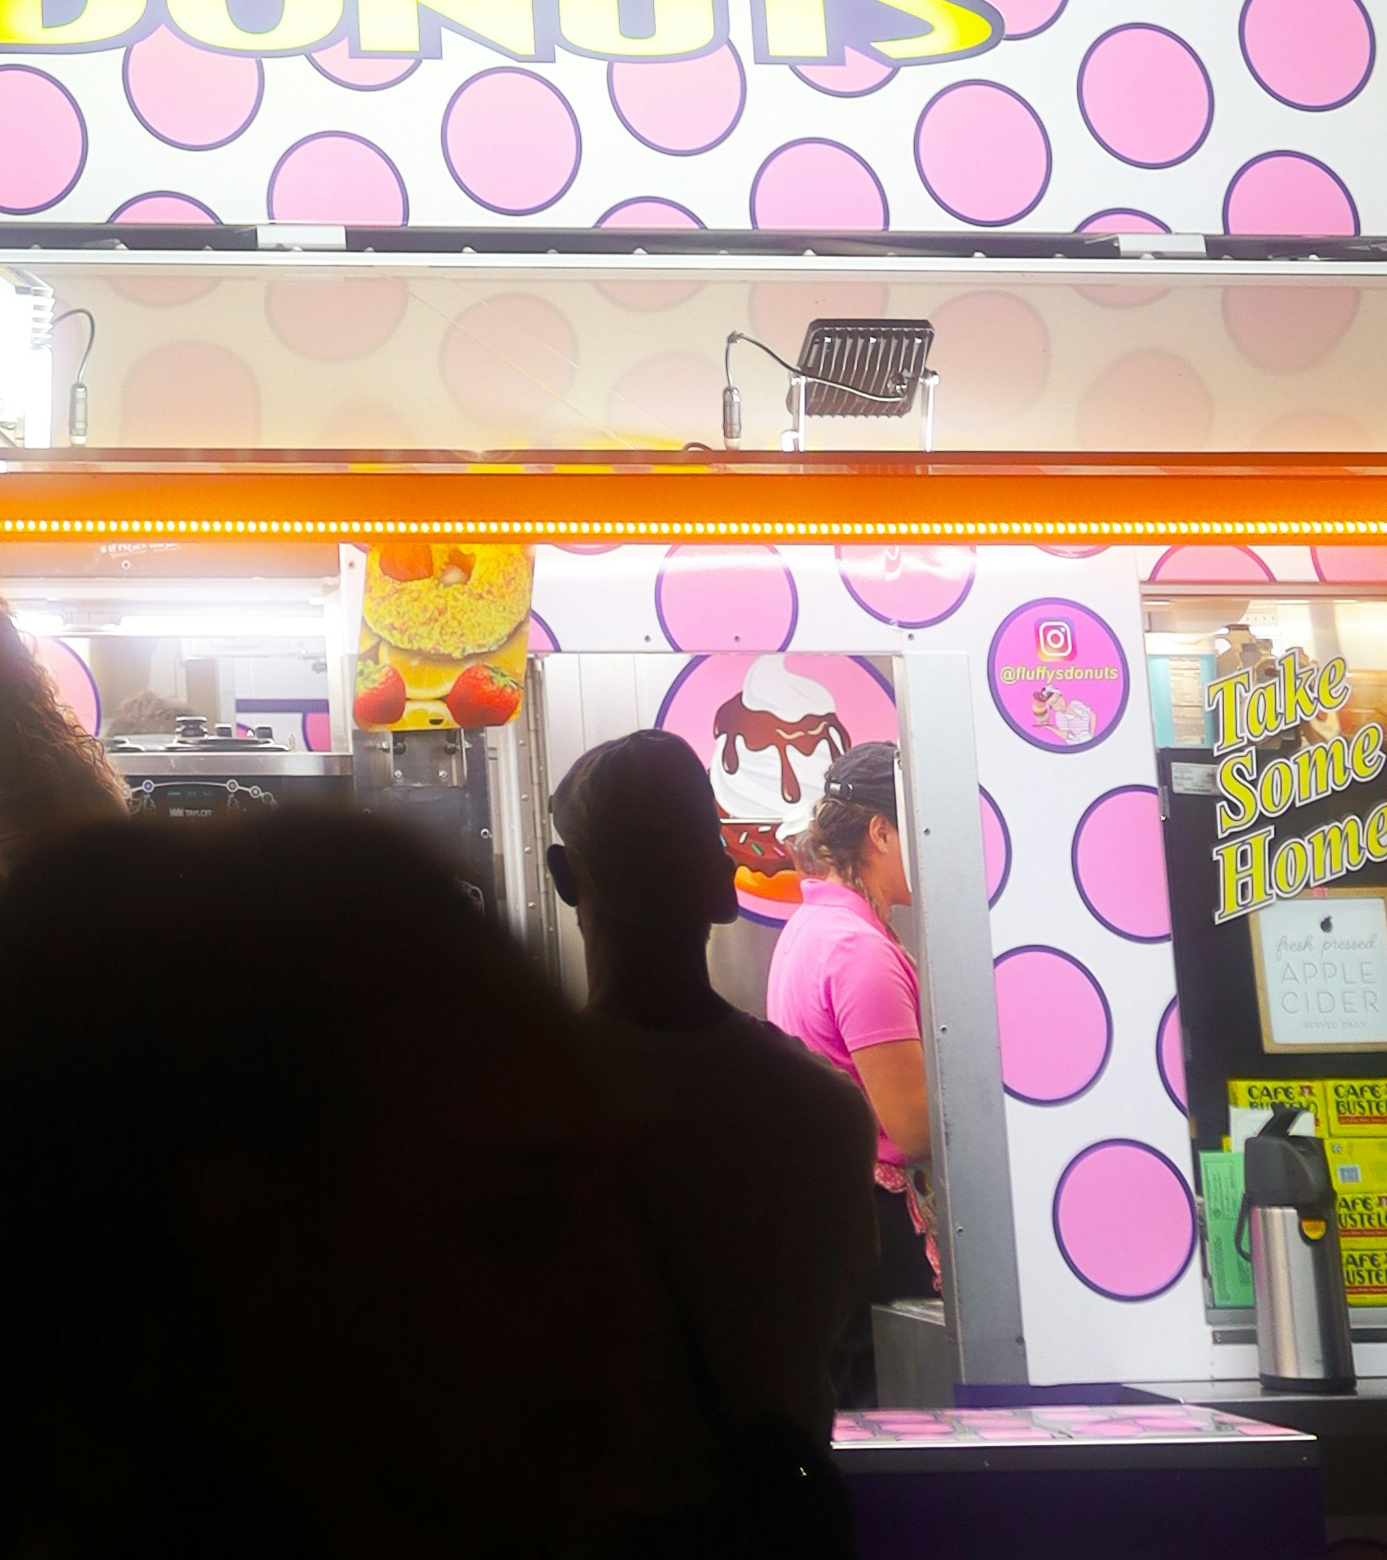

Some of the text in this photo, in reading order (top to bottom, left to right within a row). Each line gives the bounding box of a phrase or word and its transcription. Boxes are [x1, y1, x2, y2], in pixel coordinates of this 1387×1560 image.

[1001, 665, 1118, 686] @fluffysdonuts
[1205, 648, 1351, 756] Take
[1216, 722, 1387, 838] Some
[1213, 802, 1387, 925] Home
[1276, 933, 1378, 961] fresh pressed
[1282, 961, 1377, 984] APPLE
[1282, 990, 1380, 1014] CIDER
